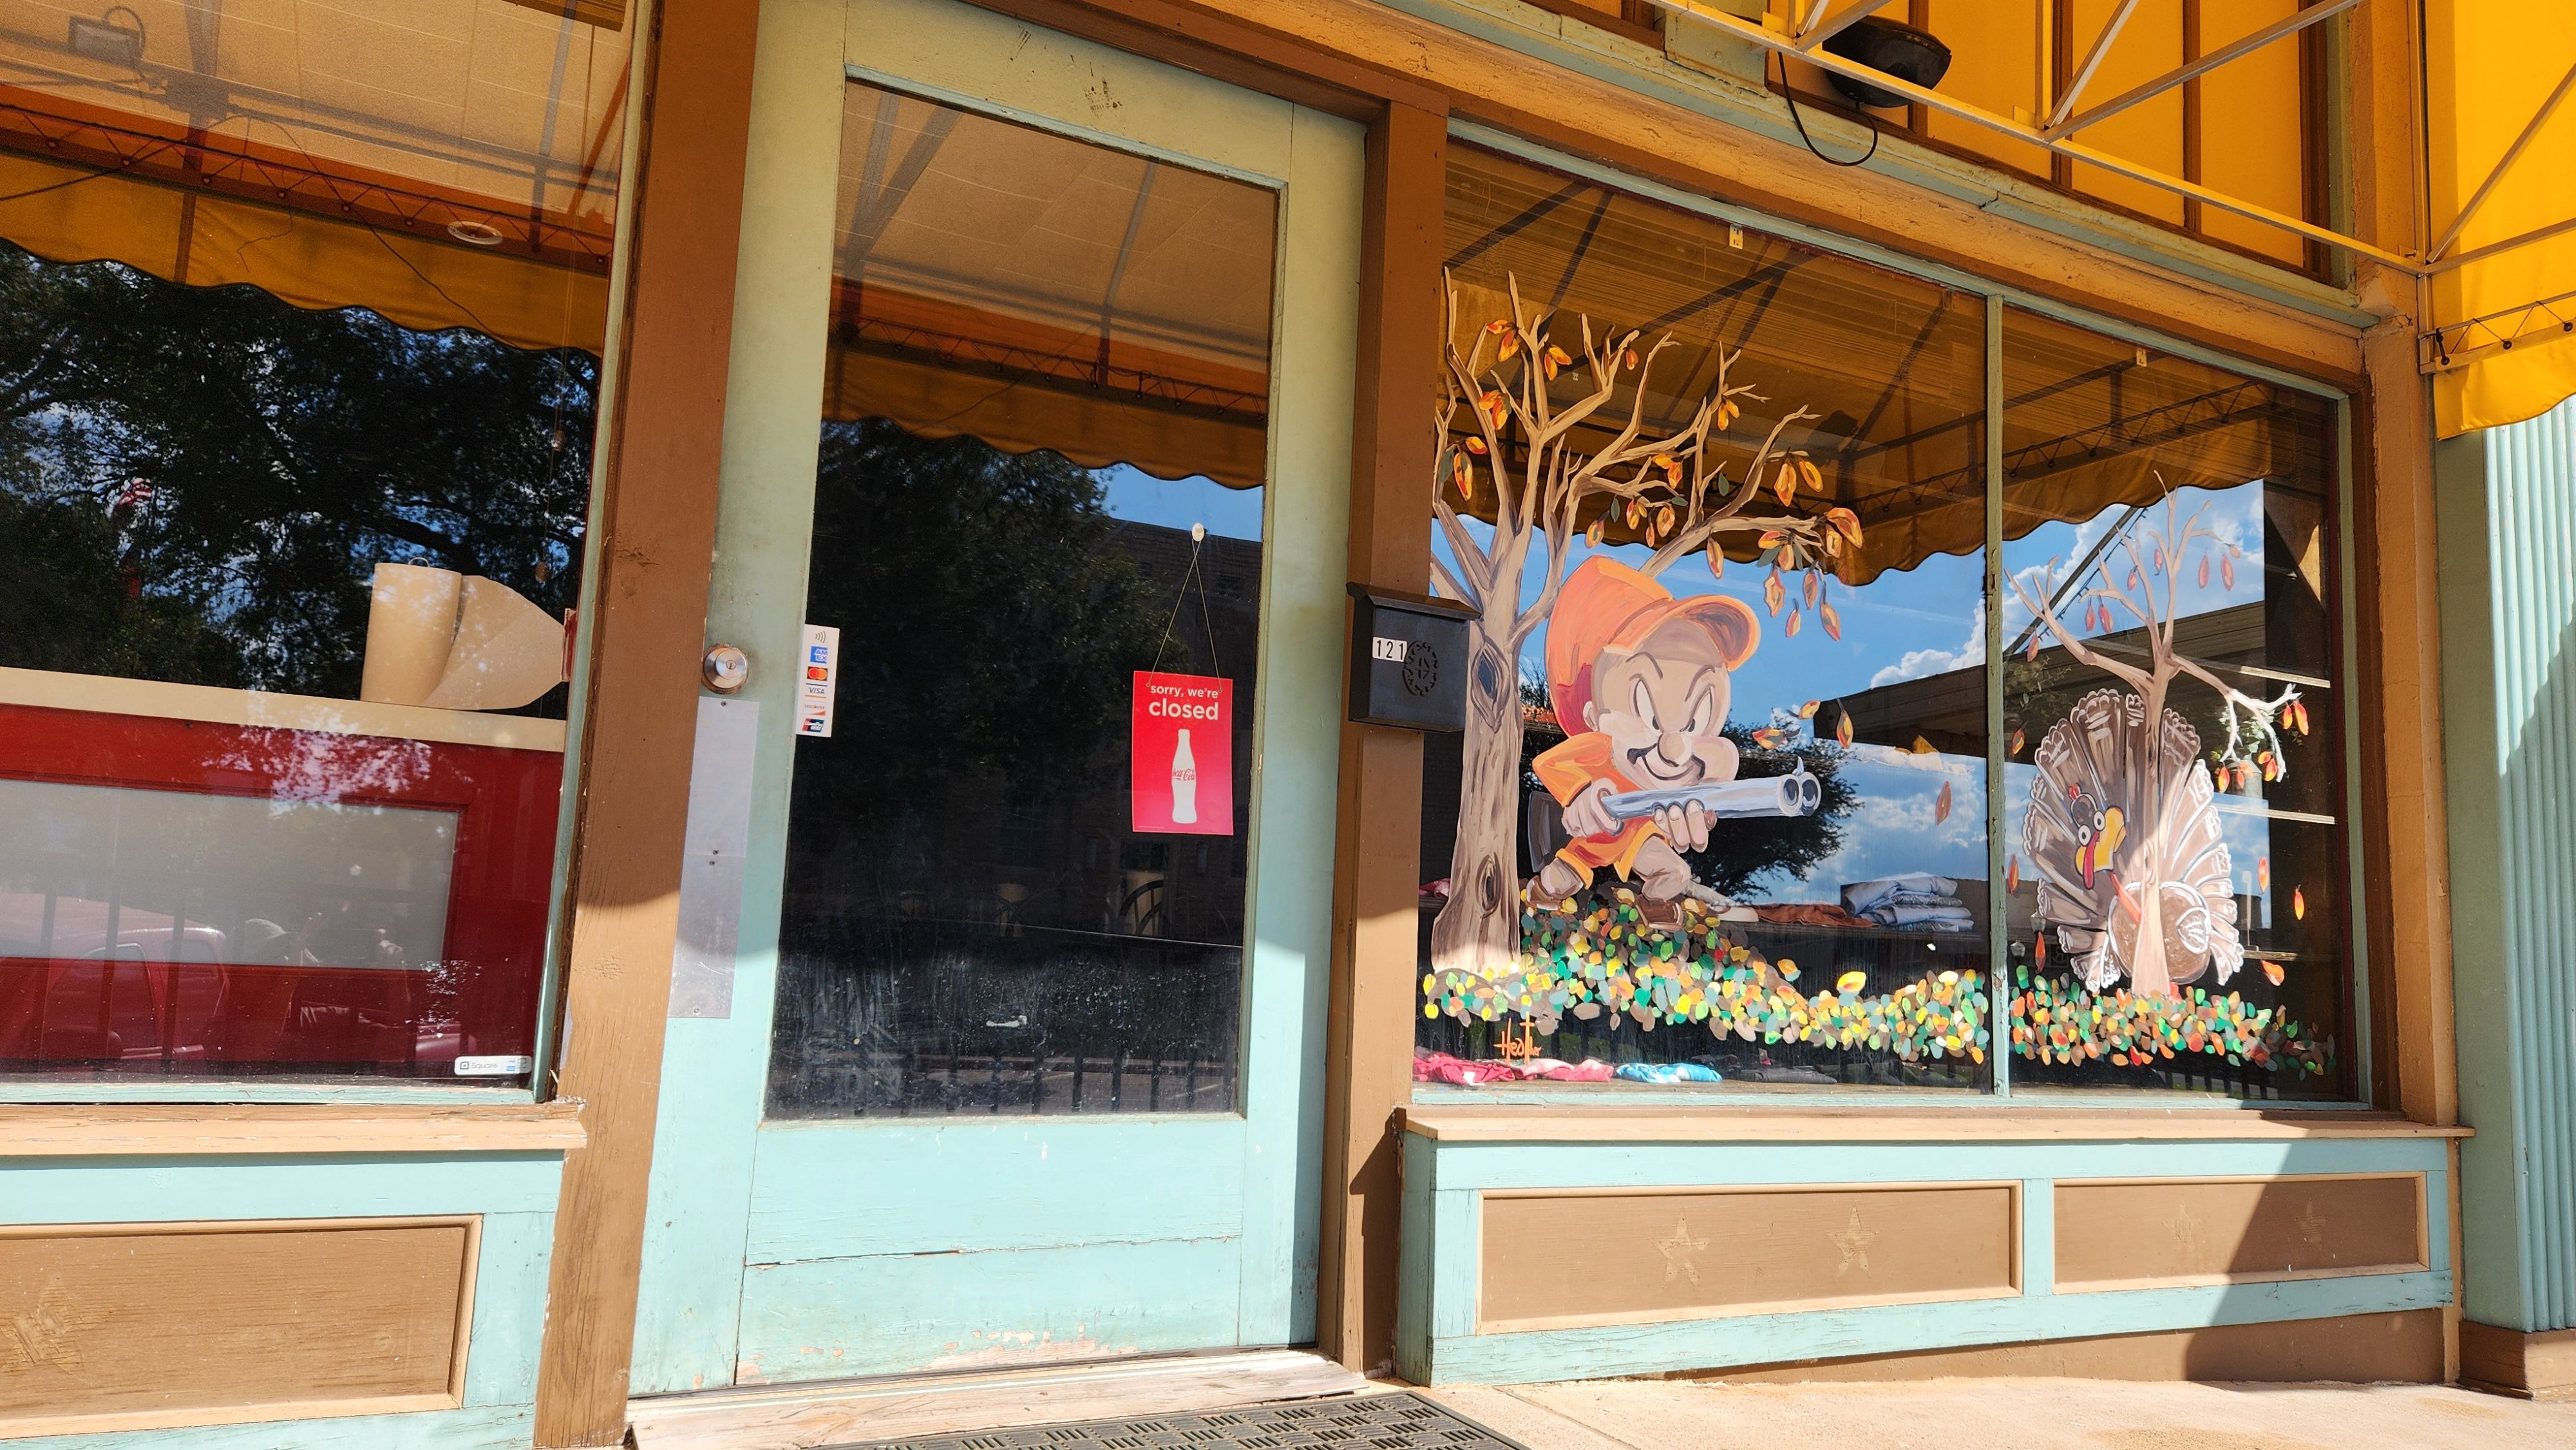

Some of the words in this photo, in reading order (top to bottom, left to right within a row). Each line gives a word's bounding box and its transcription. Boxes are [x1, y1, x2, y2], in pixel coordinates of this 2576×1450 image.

[1376, 639, 1403, 660] 121
[1150, 685, 1184, 697] sorry,
[1188, 688, 1218, 699] we're
[1148, 698, 1218, 720] closed
[1493, 1011, 1543, 1066] Heather
